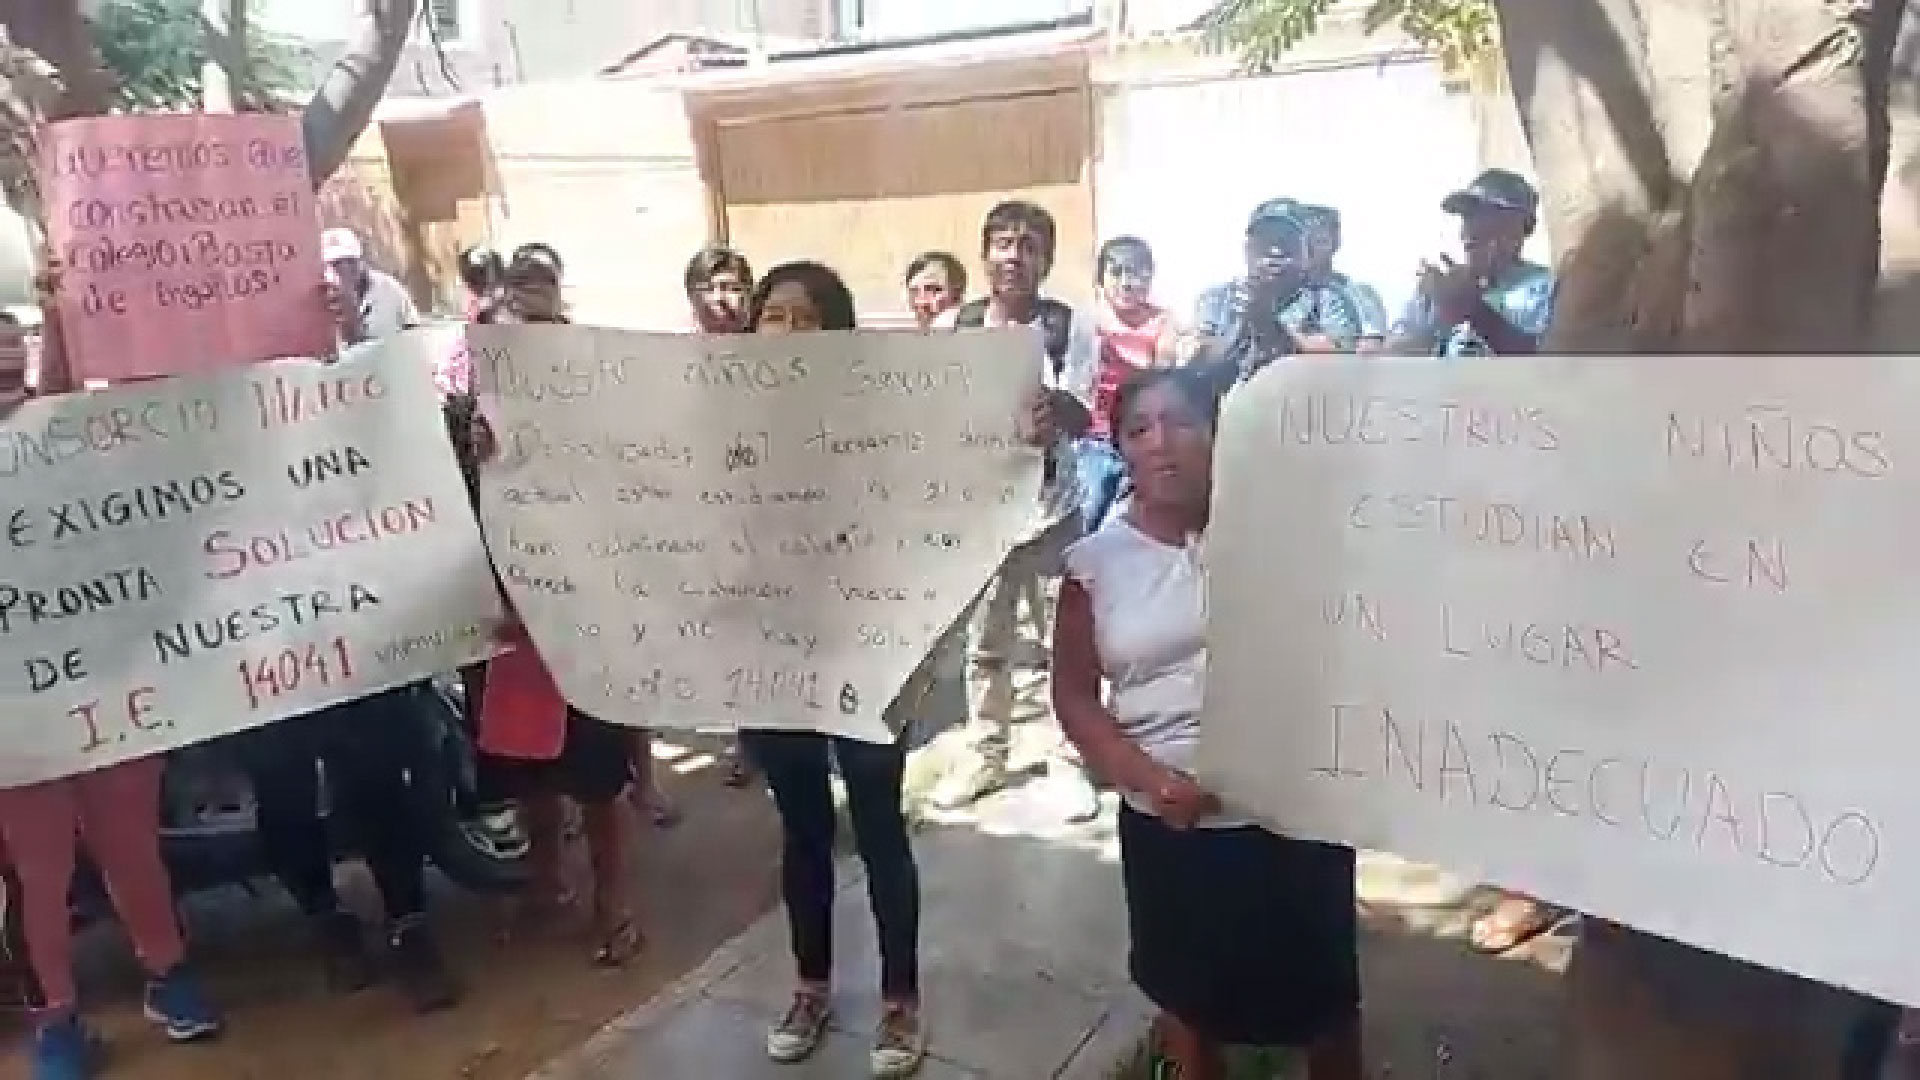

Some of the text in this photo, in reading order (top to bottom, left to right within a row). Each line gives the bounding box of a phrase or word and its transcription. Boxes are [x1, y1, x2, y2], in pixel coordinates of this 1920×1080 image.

[1665, 403, 1892, 478] NIÑOS
[8, 446, 371, 547] EXIGIMOS UNA
[0, 497, 436, 634] PRONTA SOLUCION
[1687, 537, 1788, 592] EN
[23, 648, 88, 693] DE
[152, 584, 381, 664] NUESTRA
[1322, 592, 1640, 671] UN LUGAR
[67, 686, 175, 752] I.E.
[237, 636, 352, 710] 14041
[1307, 702, 1881, 886] INADECUADO
